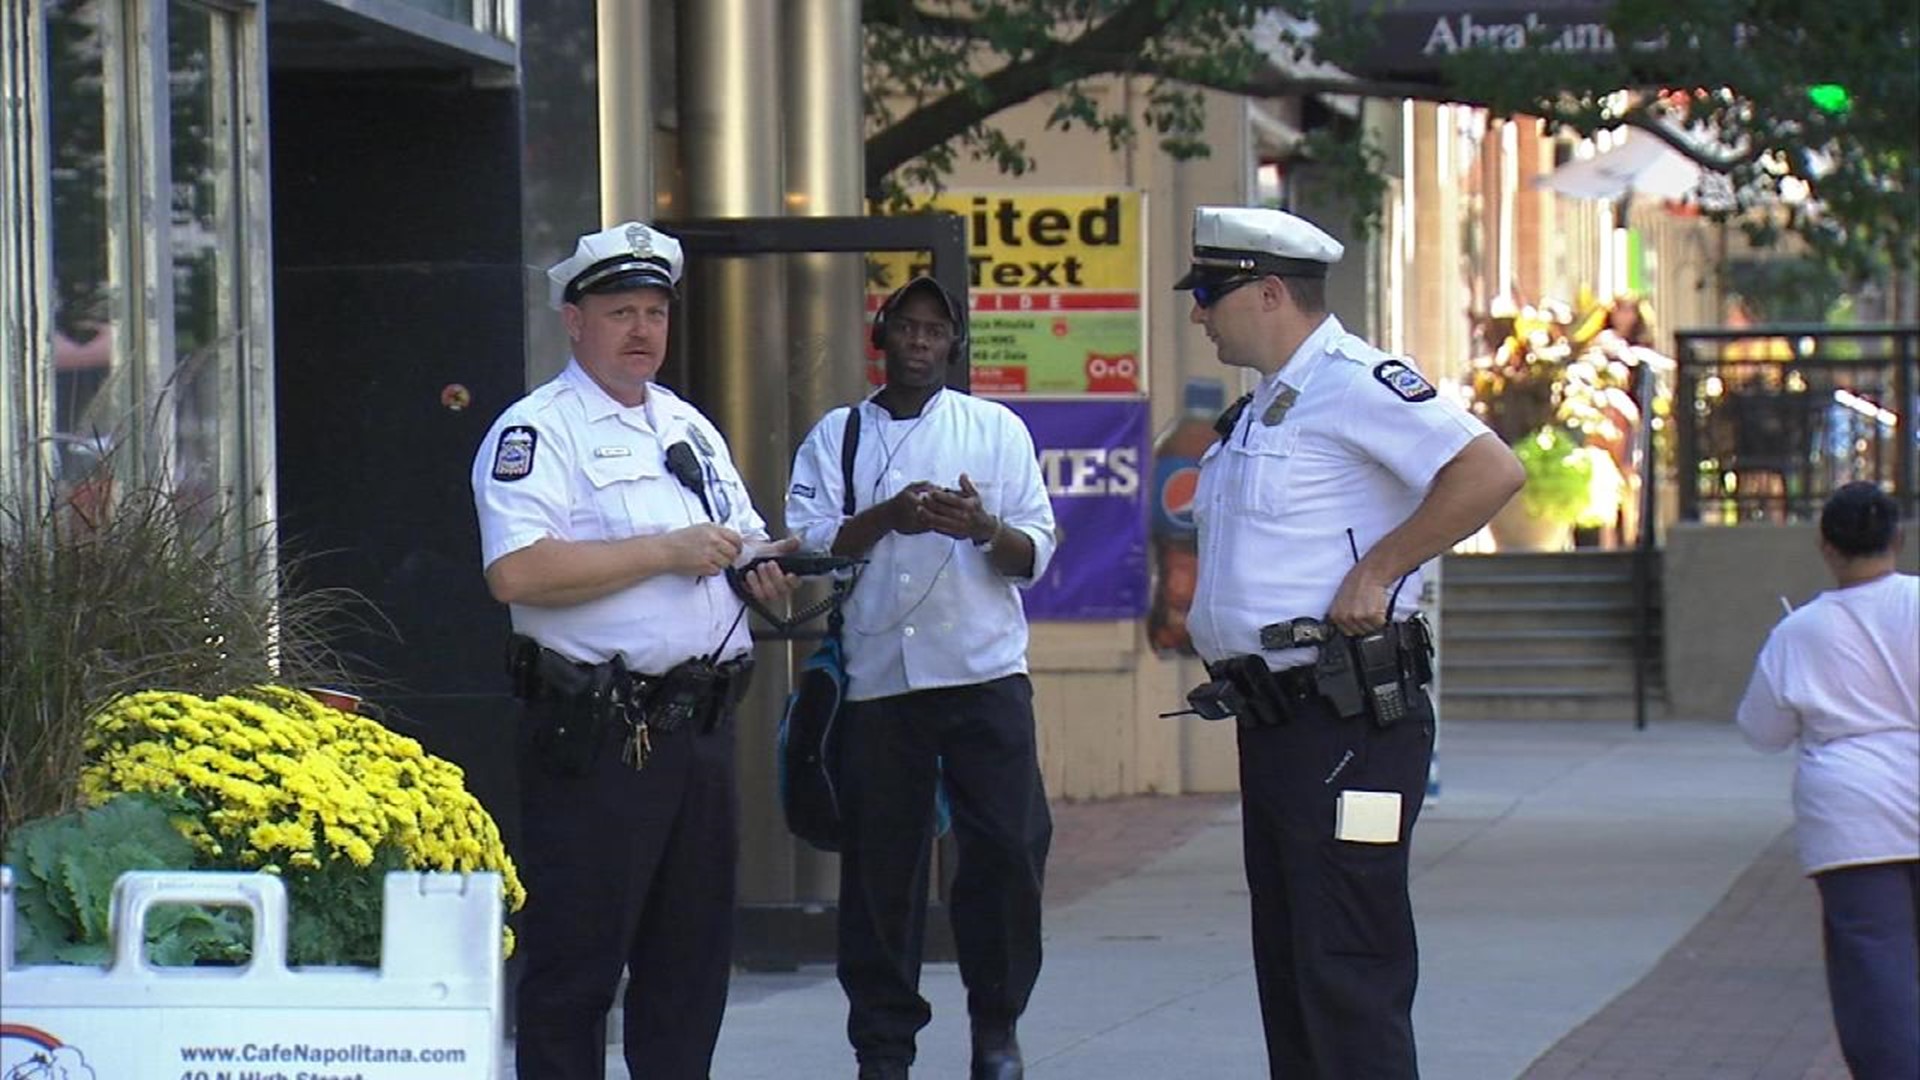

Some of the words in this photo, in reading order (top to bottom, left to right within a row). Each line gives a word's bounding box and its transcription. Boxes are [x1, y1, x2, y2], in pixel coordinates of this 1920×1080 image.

[972, 196, 1120, 247] ited
[968, 255, 1083, 287] Text
[180, 1043, 467, 1067] www.CafeNapolitana.com
